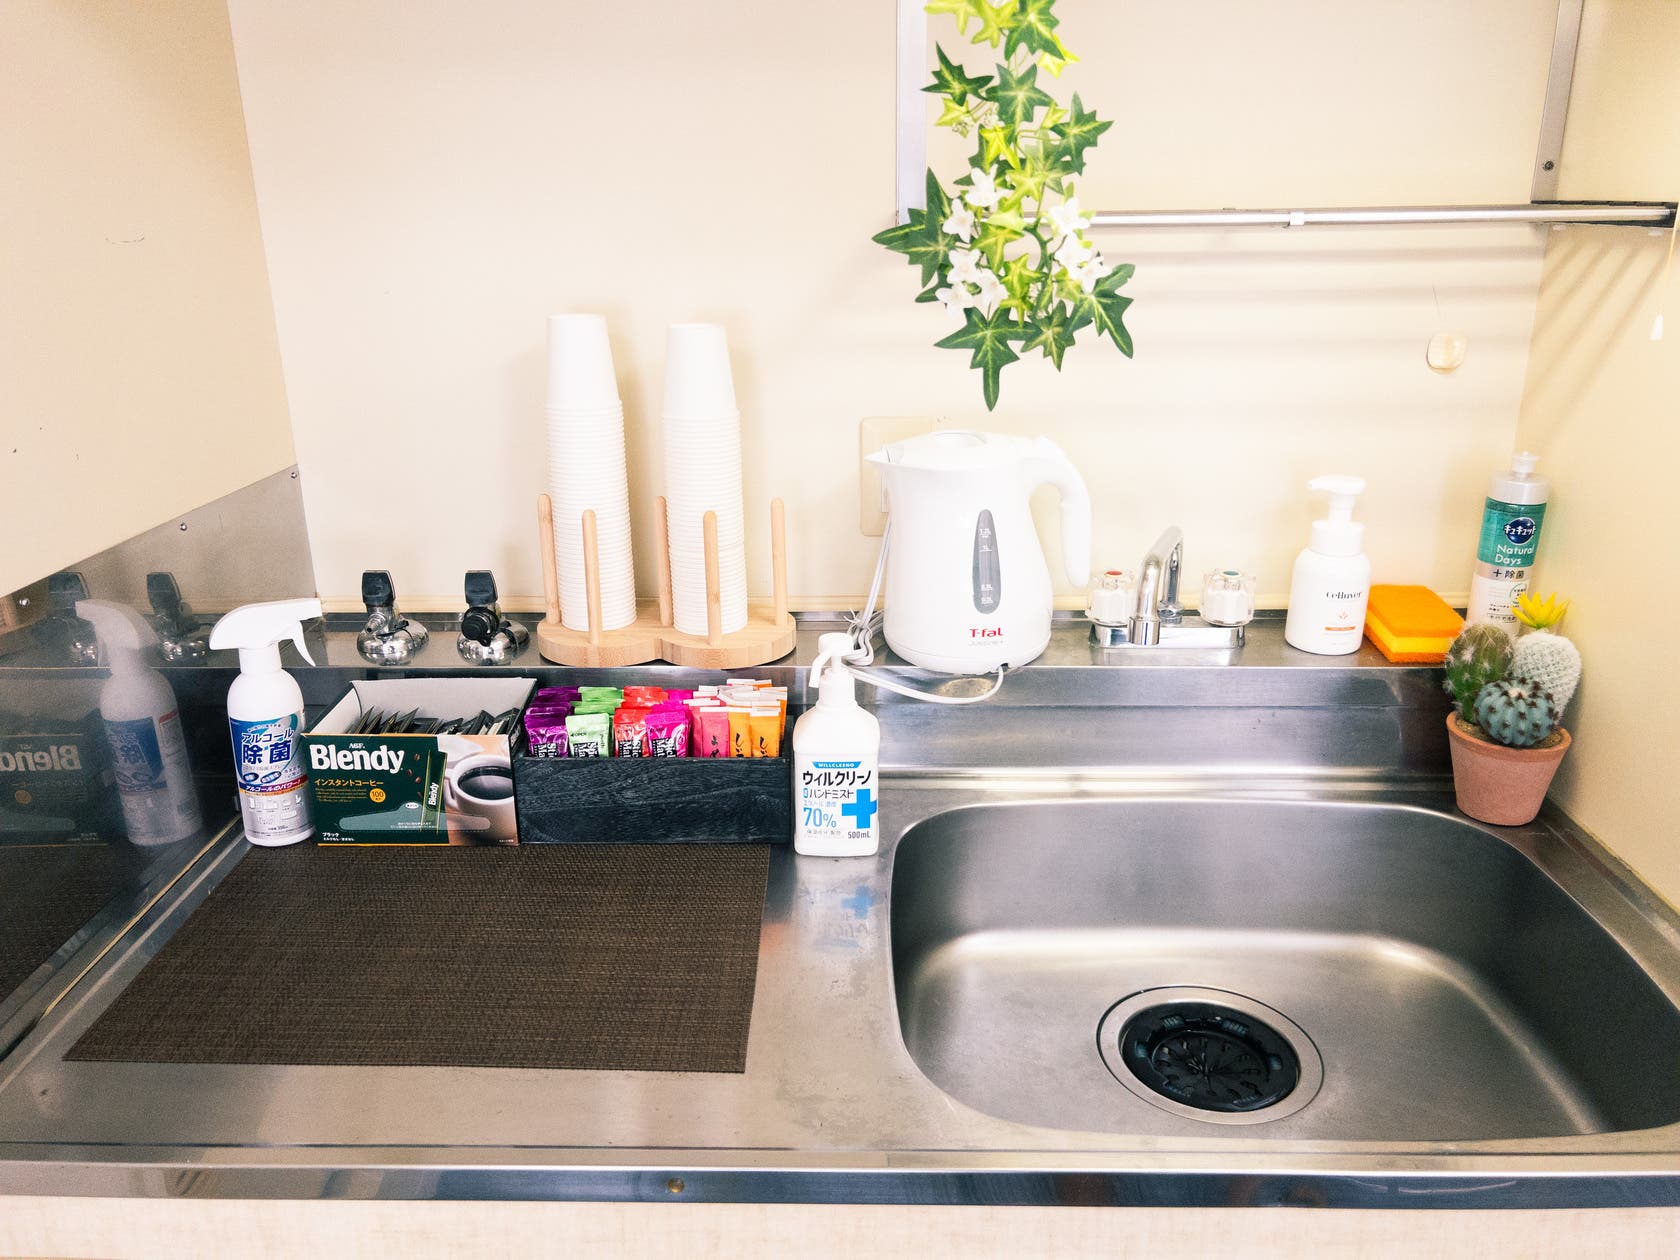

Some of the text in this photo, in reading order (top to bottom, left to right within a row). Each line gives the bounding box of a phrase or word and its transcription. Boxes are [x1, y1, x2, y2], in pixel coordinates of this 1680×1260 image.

[1497, 544, 1534, 555] Natural
[1495, 554, 1521, 566] Days
[969, 627, 1004, 638] T-fal
[242, 728, 294, 743] アルコール
[243, 740, 291, 764] 除菌
[309, 744, 405, 774] Blendy
[315, 779, 384, 787] インスタントコーヒー
[802, 770, 871, 786] ウィルクリーノ
[428, 782, 440, 806] Blendy
[809, 788, 854, 799] ハンドミスト
[803, 807, 837, 828] 70%
[848, 831, 871, 839] 500mL
